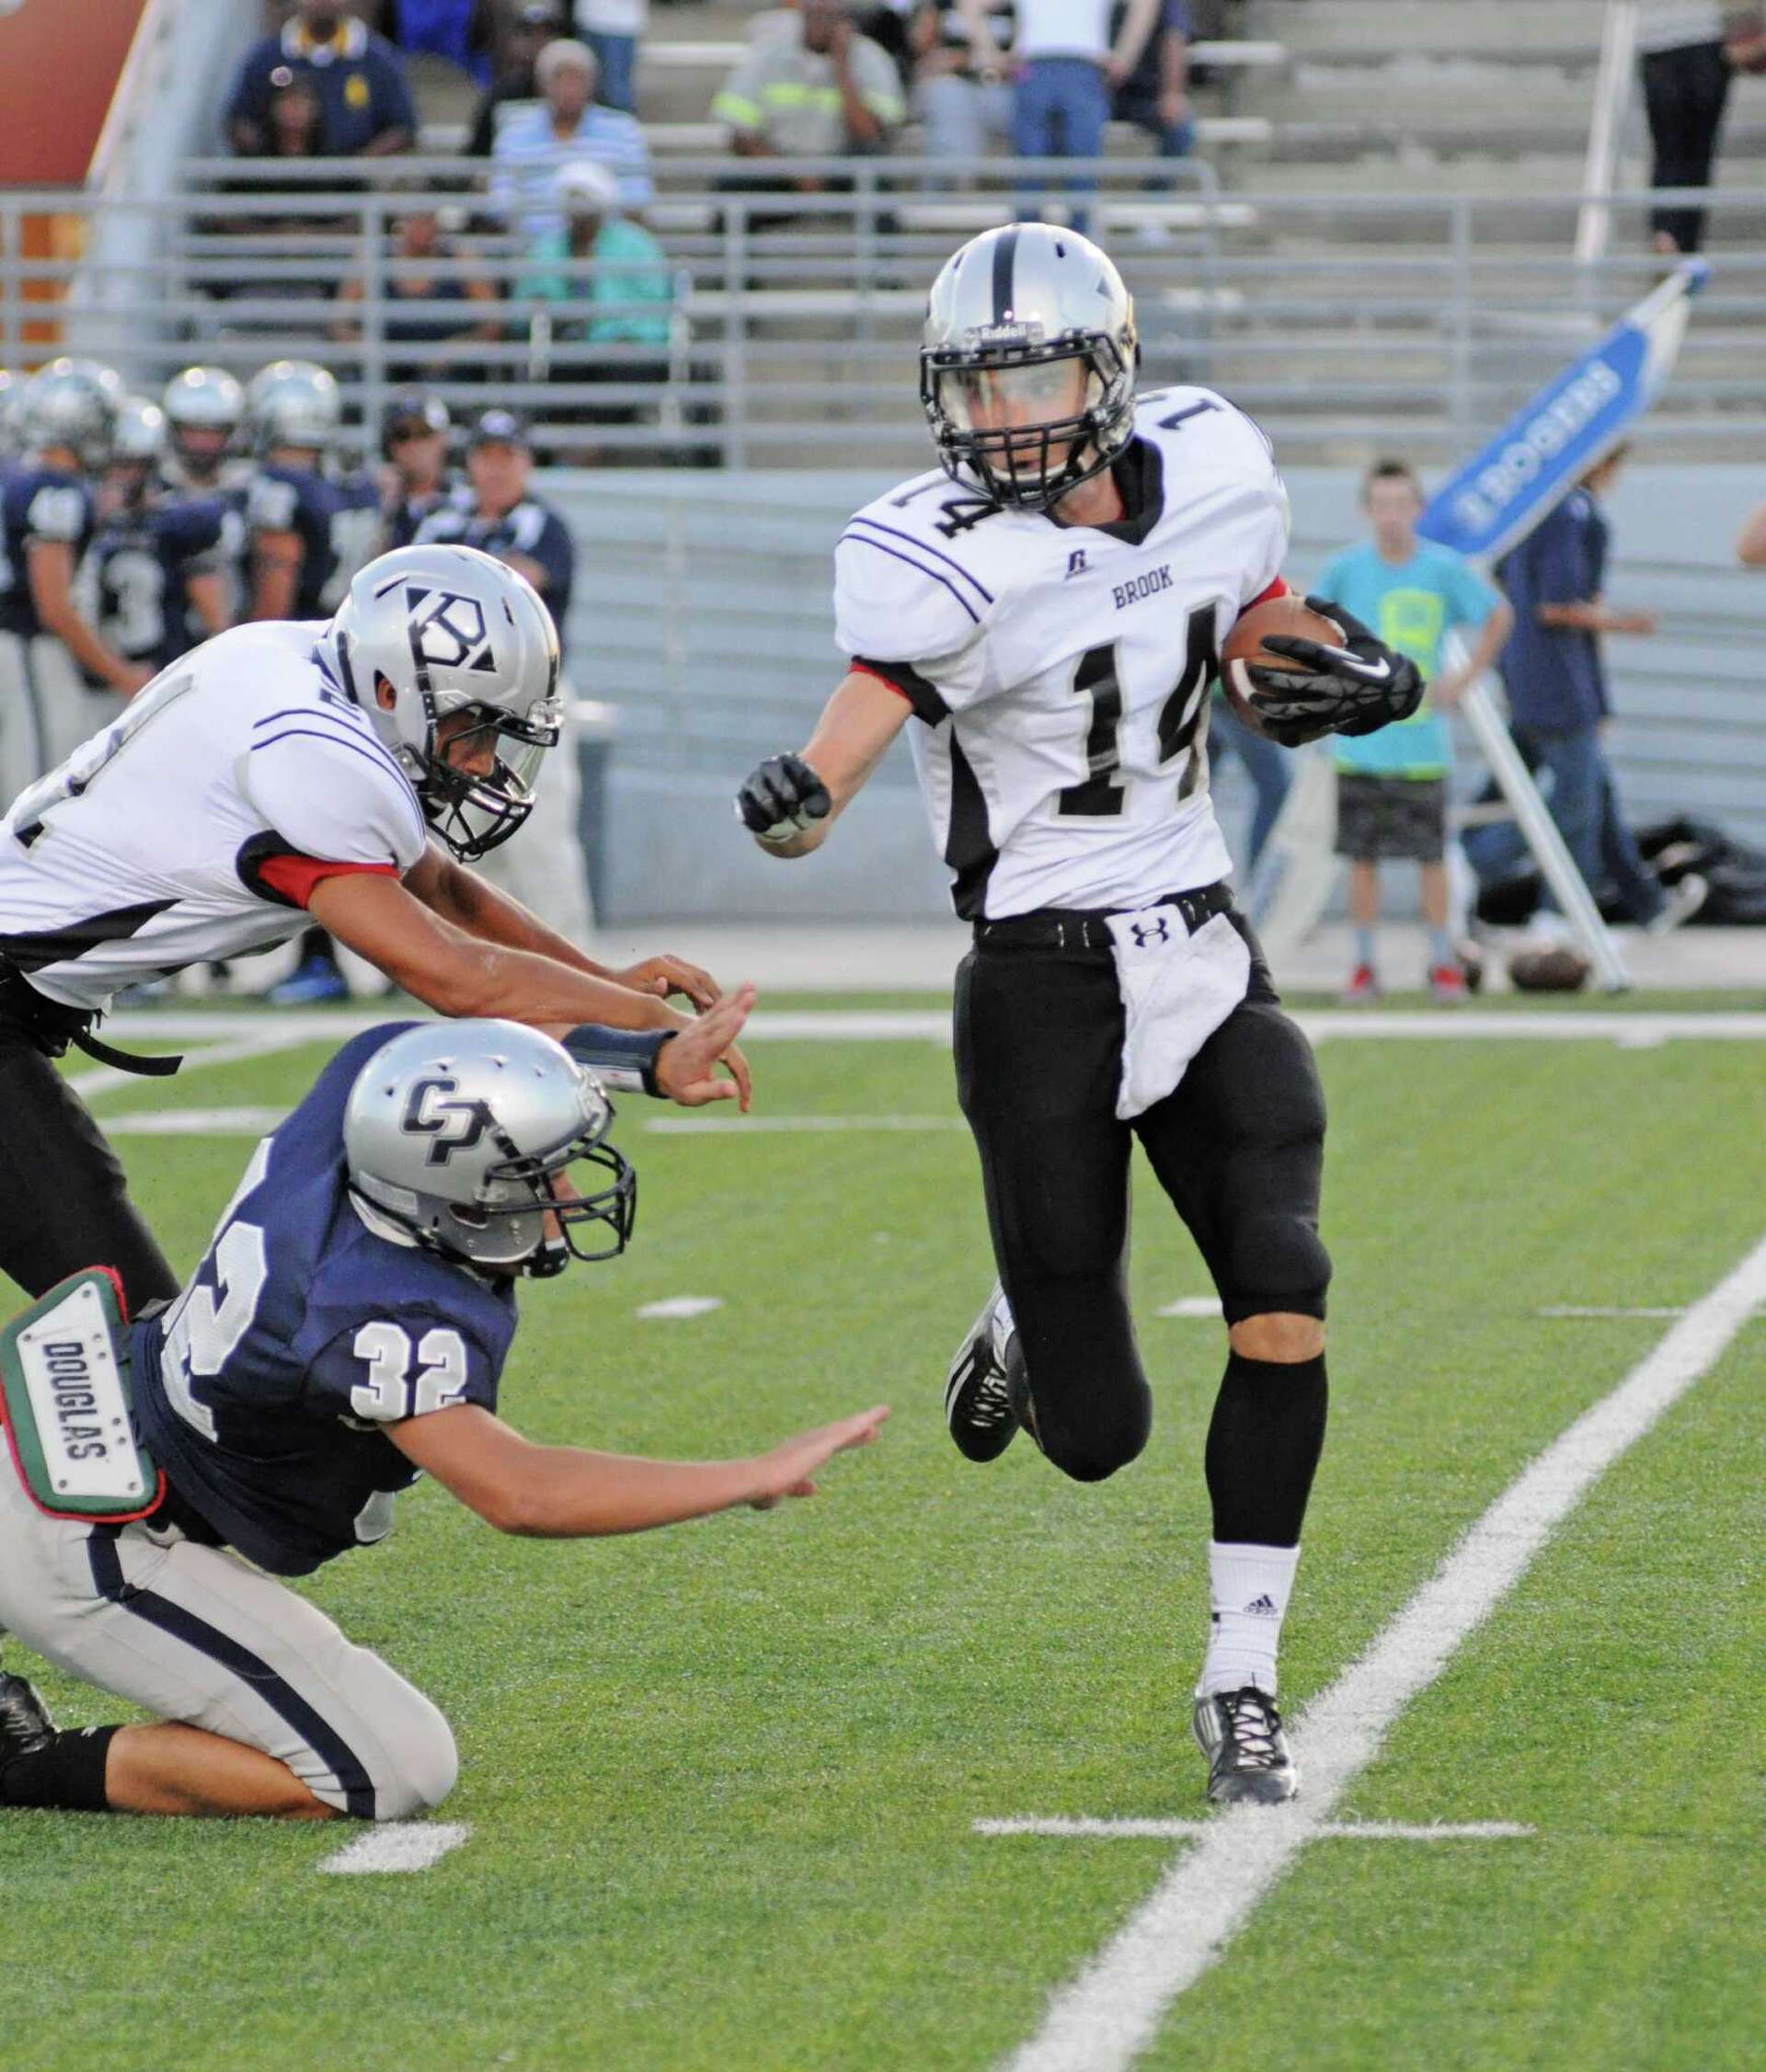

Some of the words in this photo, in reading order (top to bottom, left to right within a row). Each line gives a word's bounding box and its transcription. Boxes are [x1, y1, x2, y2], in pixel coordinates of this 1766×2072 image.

[1111, 564, 1174, 610] BROOK
[1058, 601, 1219, 816] 14
[42, 1342, 108, 1460] DOUGLAS
[350, 1321, 466, 1422] 32
